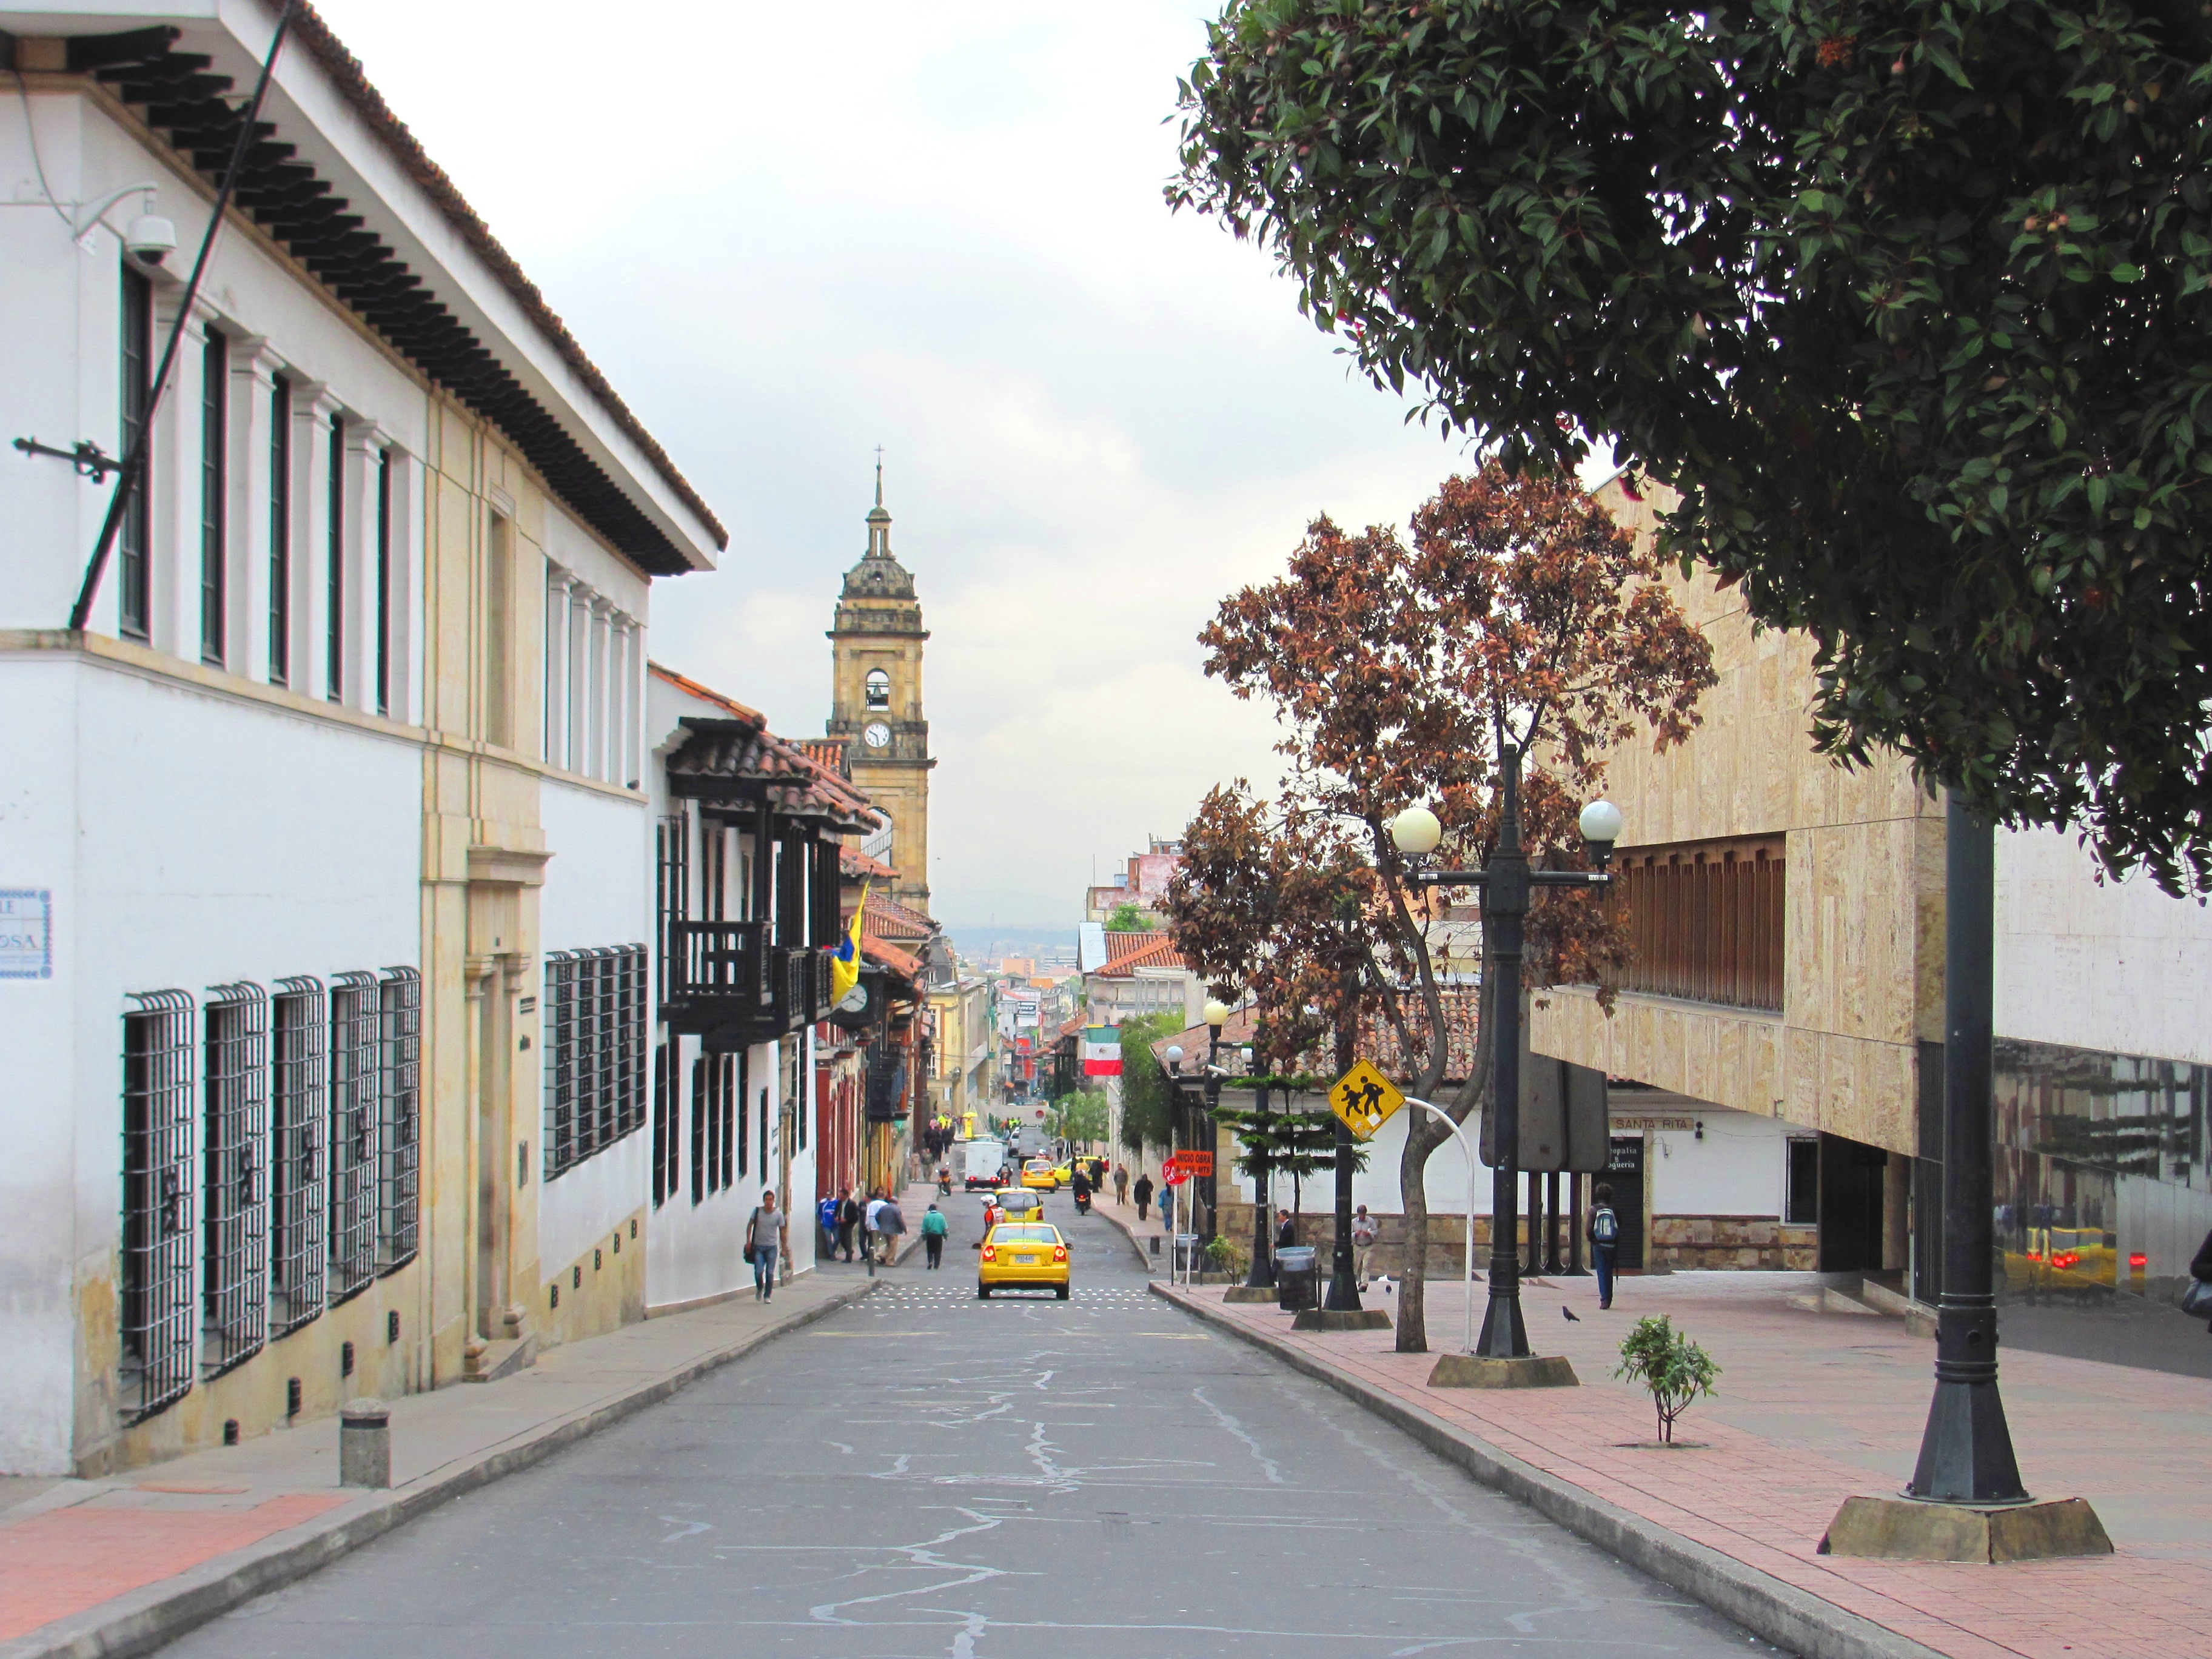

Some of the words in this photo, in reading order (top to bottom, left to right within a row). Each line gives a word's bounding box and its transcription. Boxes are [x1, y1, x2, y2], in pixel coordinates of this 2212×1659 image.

[1616, 1119, 1655, 1128] SANTA
[1663, 1119, 1687, 1128] RITA
[1177, 1154, 1193, 1162] INICIO
[1196, 1155, 1210, 1163] OBRA
